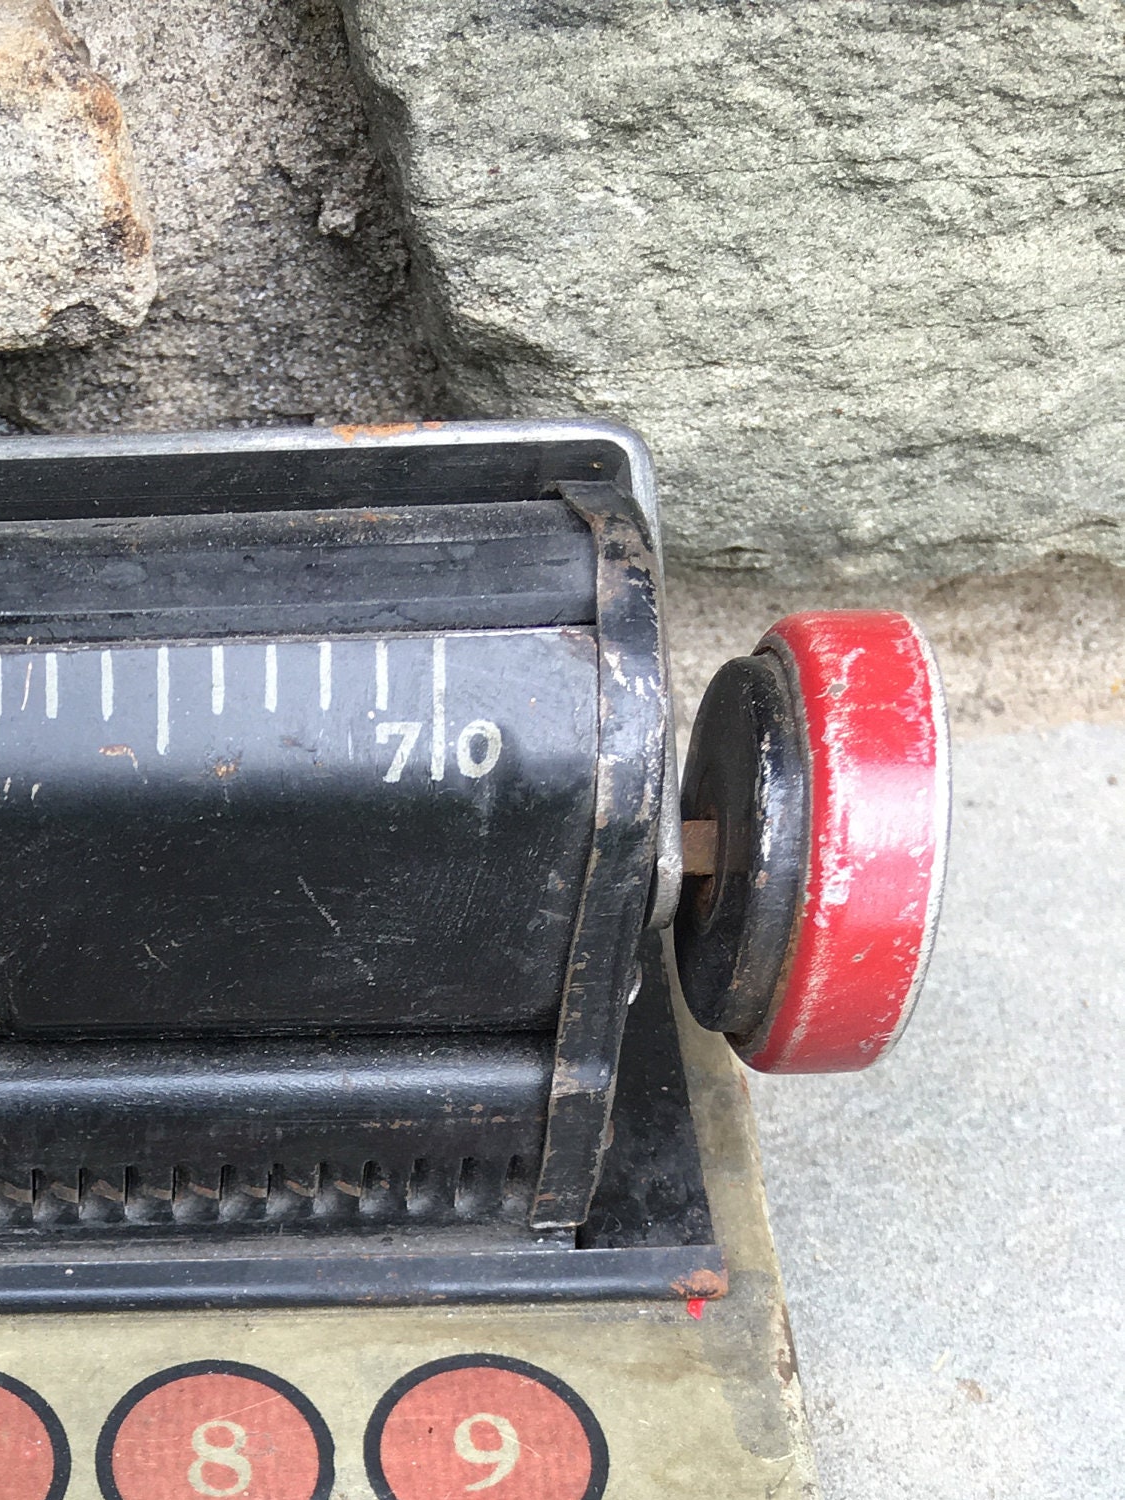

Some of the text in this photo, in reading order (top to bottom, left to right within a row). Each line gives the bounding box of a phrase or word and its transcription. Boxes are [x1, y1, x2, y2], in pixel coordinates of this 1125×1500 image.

[375, 718, 503, 783] 70
[186, 1420, 252, 1498] 8
[452, 1411, 520, 1492] 9
